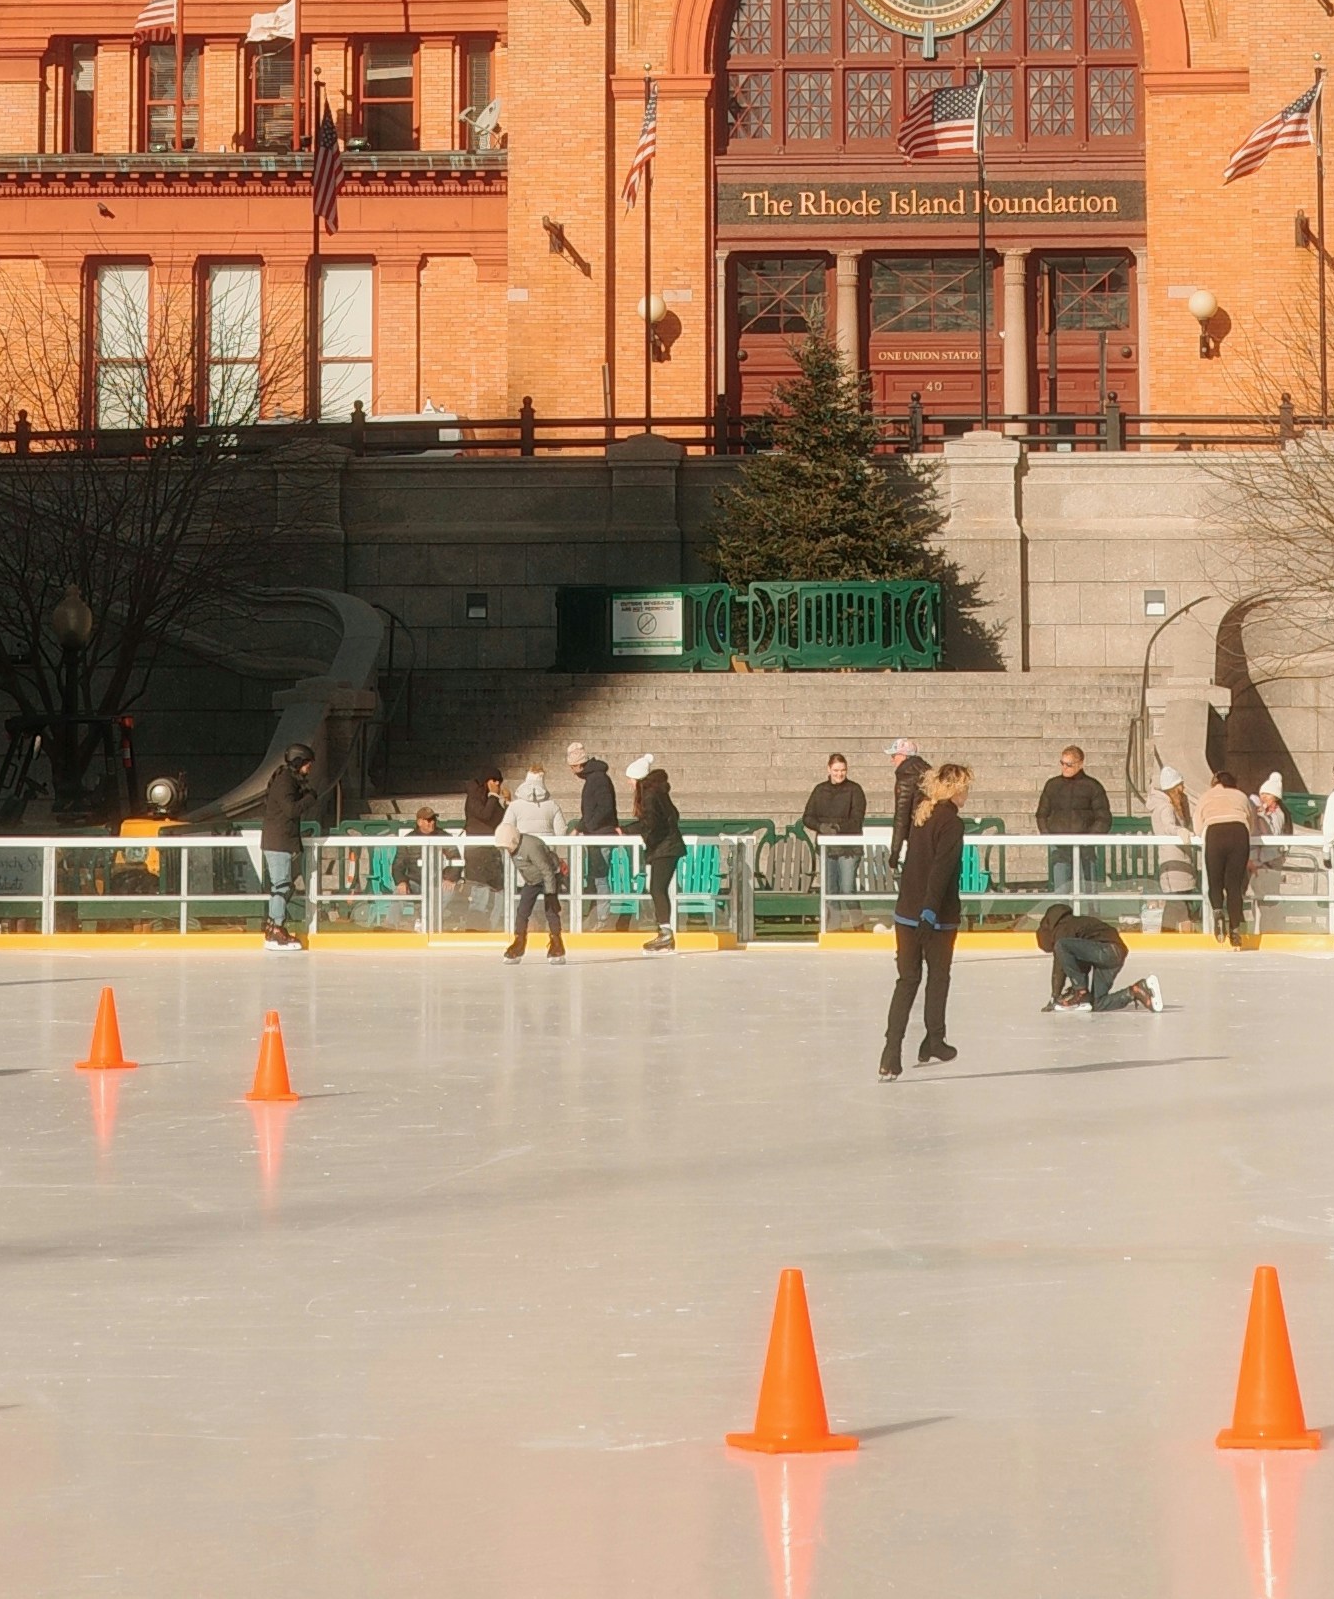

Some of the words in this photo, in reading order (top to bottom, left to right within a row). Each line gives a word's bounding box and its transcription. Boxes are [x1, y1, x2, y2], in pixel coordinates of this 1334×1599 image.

[742, 190, 793, 216] The
[798, 190, 882, 216] Rhode
[888, 188, 965, 215] Island
[973, 188, 1118, 214] Foundation
[878, 351, 902, 360] ONE
[903, 351, 940, 360] UNION
[926, 381, 943, 392] 40
